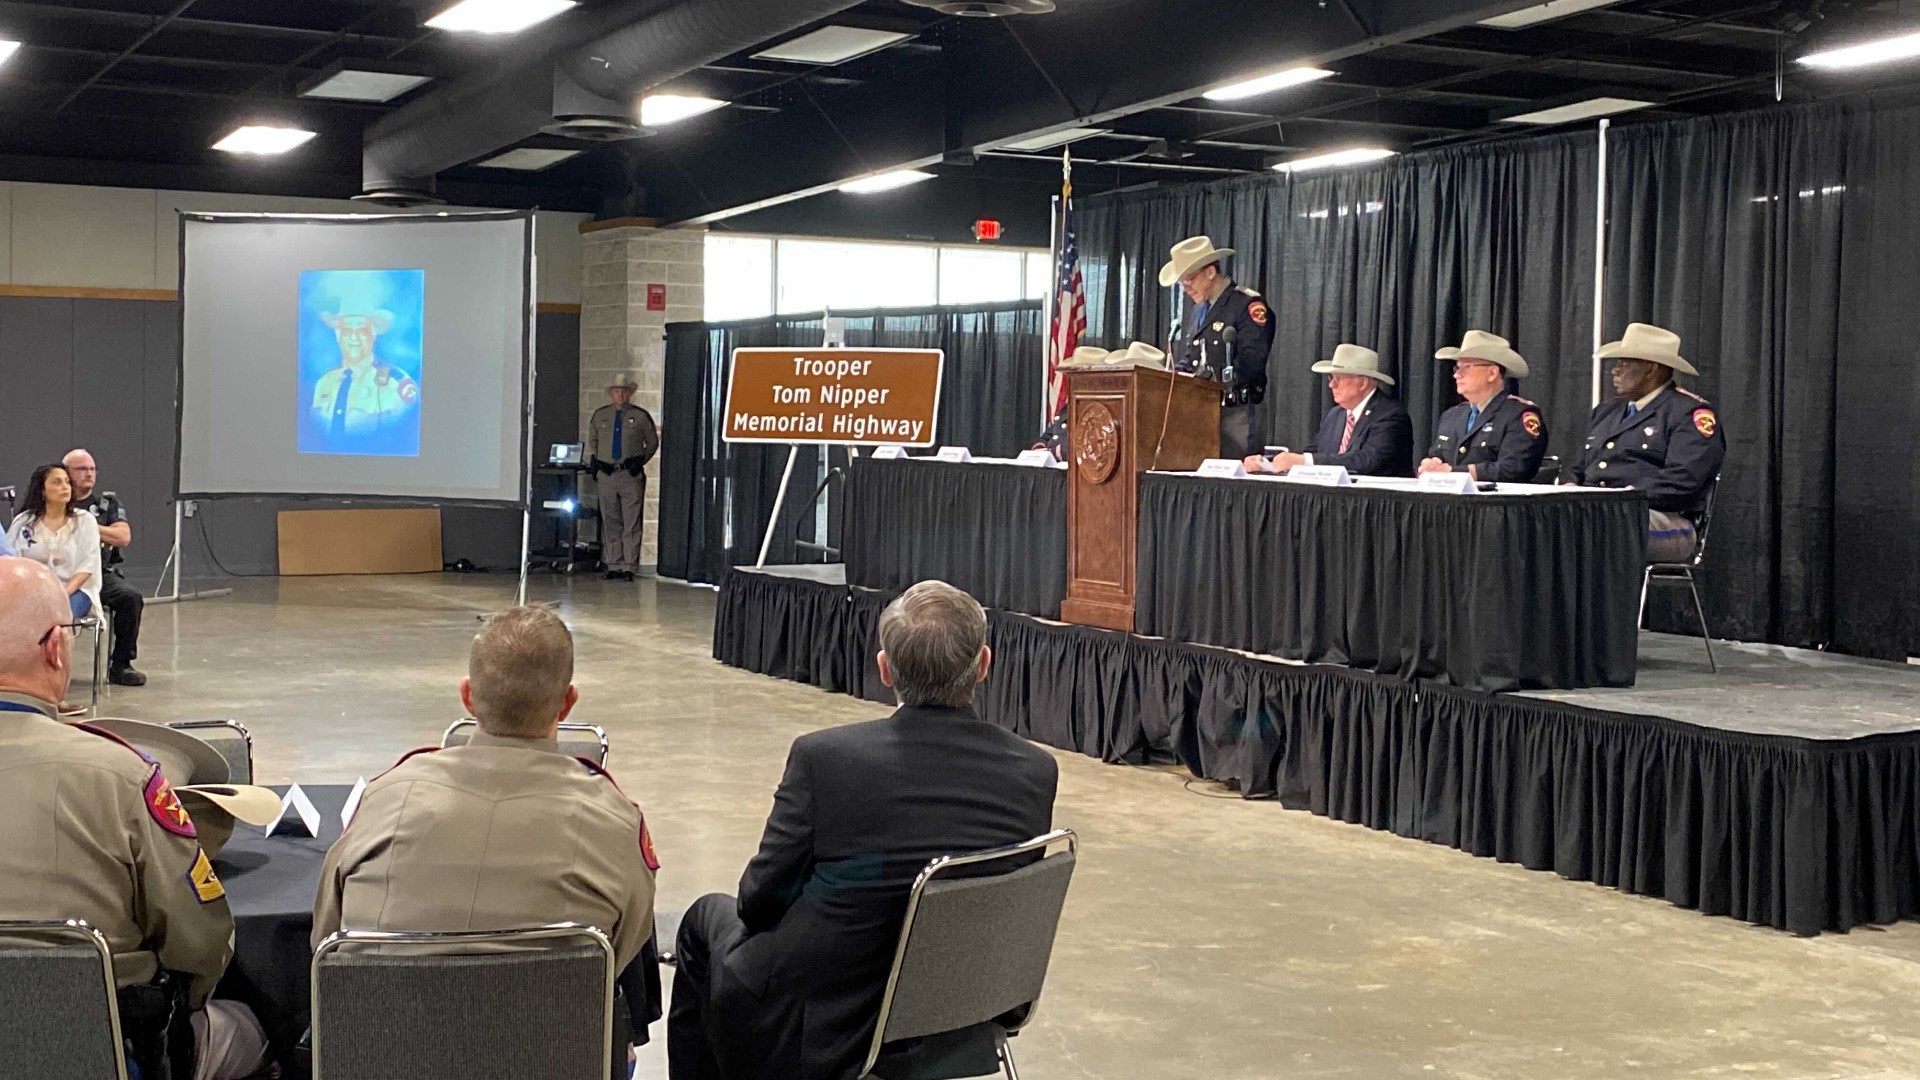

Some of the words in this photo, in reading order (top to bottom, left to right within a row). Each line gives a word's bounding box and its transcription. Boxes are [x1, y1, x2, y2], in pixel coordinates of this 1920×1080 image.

[794, 358, 871, 380] Trooper
[773, 386, 810, 403] Tom
[821, 384, 889, 408] Nipper
[734, 412, 823, 432] Memorial
[833, 413, 923, 440] Highway
